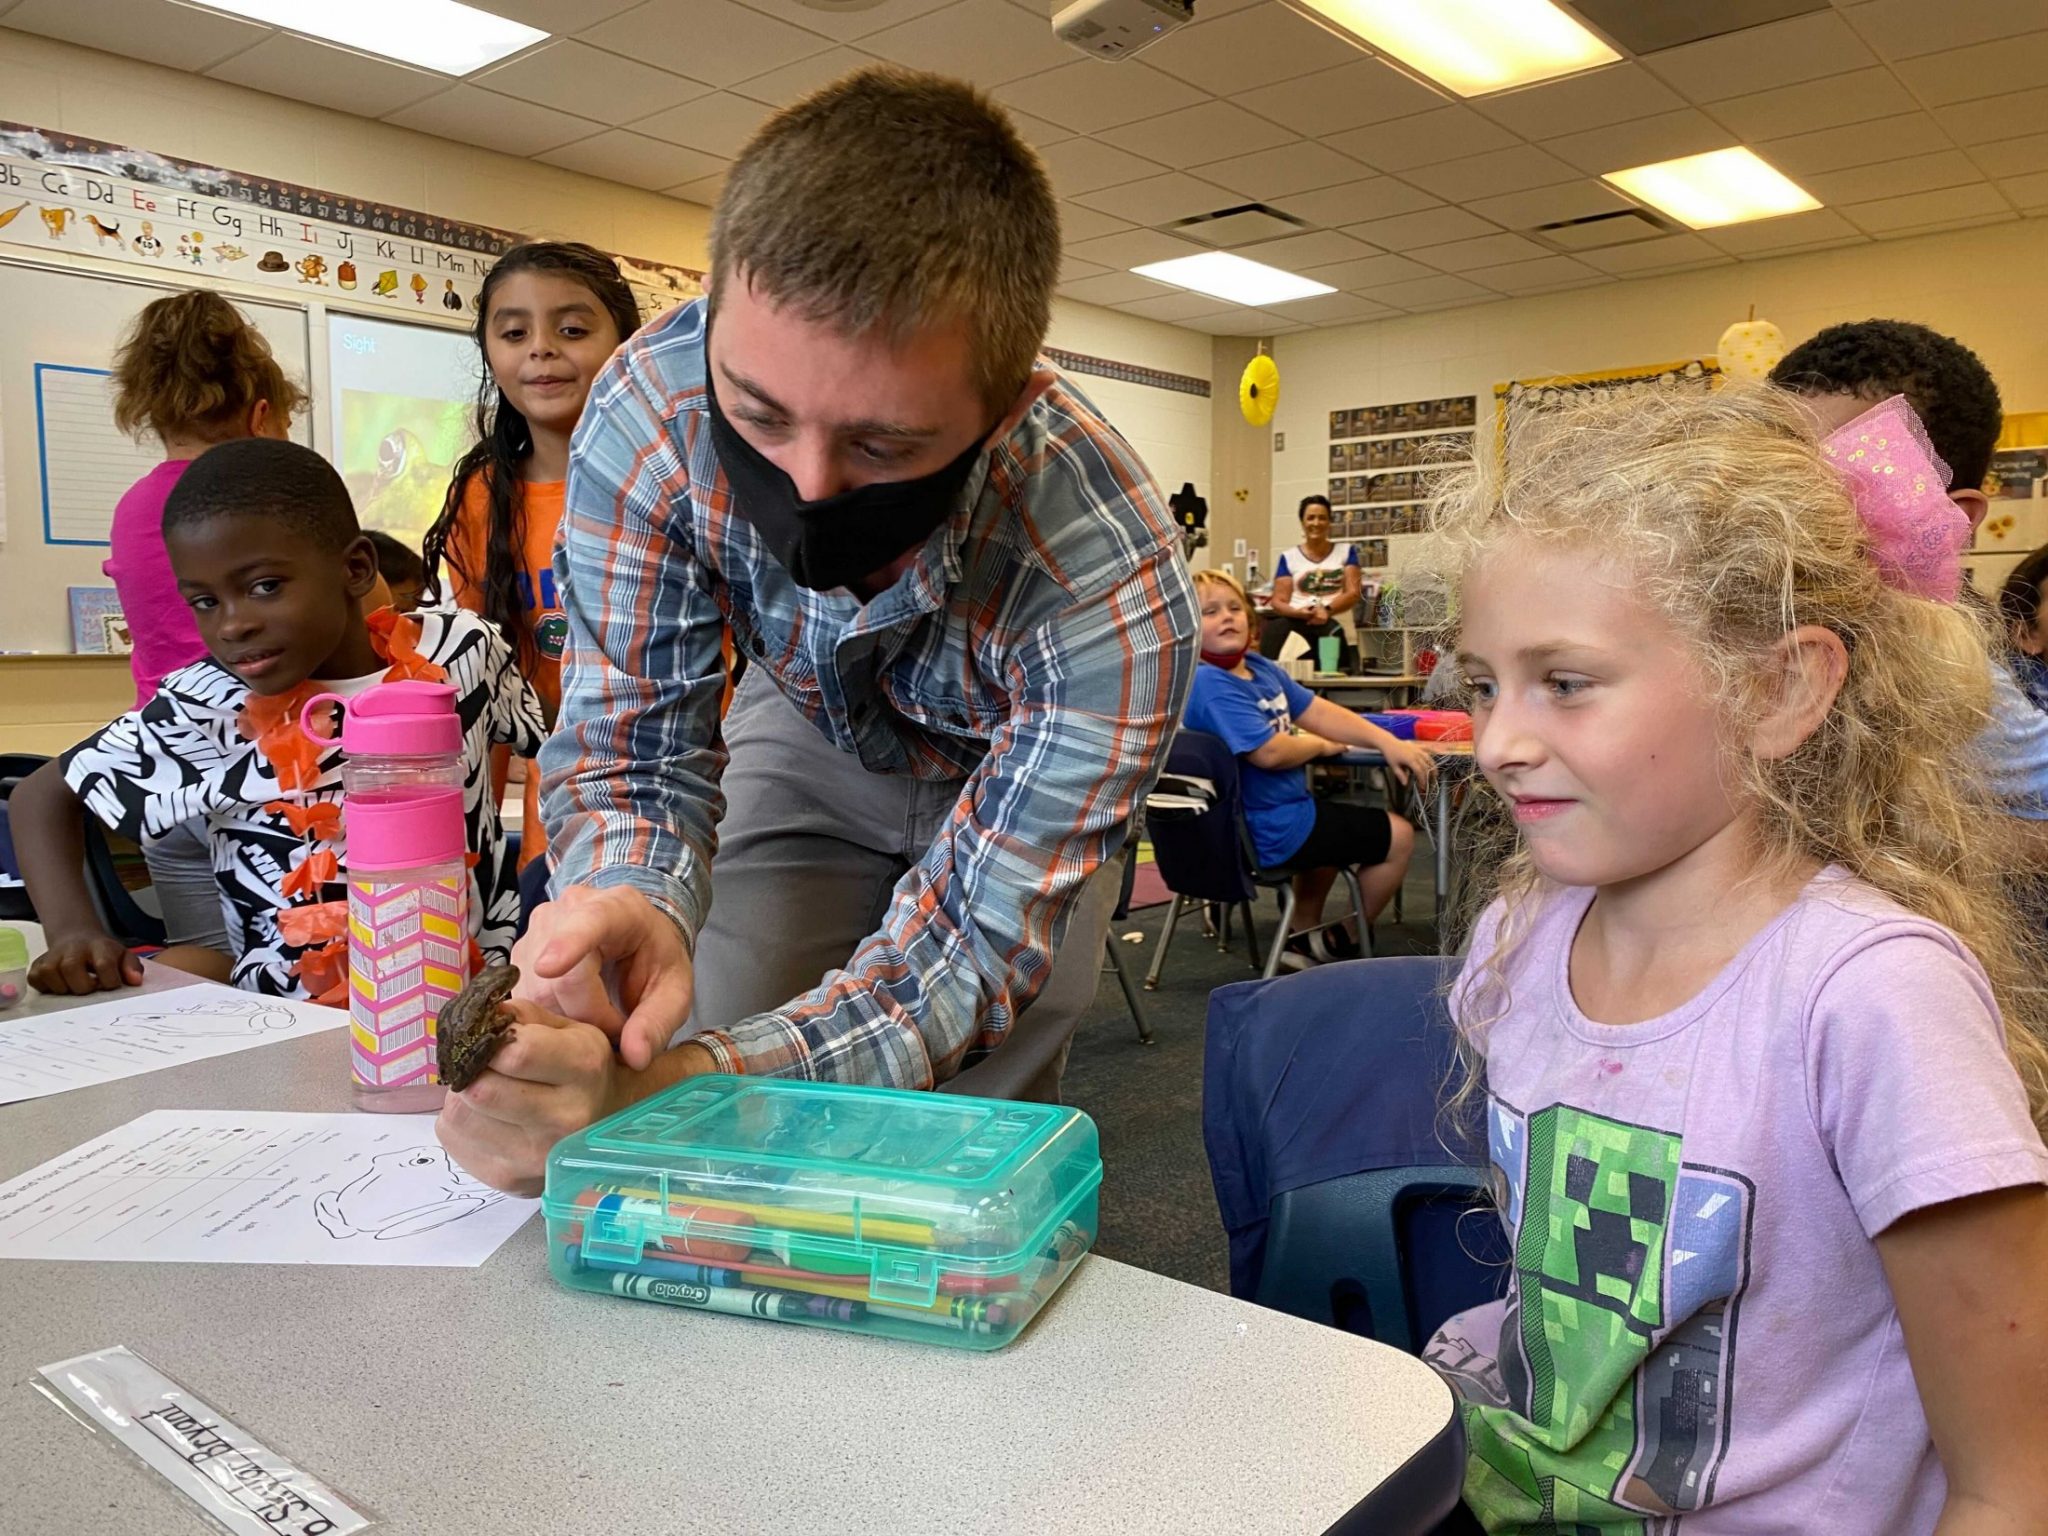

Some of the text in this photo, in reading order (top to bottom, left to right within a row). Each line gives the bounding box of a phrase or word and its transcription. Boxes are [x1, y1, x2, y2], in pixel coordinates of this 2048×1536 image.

[318, 204, 329, 218] 57
[42, 172, 68, 195] Cc
[86, 180, 113, 204] Dd
[133, 189, 156, 213] Ee
[177, 198, 197, 219] Ff
[212, 206, 241, 237] Gg
[260, 214, 283, 237] Hh
[337, 231, 353, 259] Jj
[377, 239, 396, 259] Kk
[437, 251, 464, 272] Mm
[343, 333, 375, 354] Sight
[655, 1282, 707, 1303] Crayola
[140, 1402, 233, 1464] Bryant
